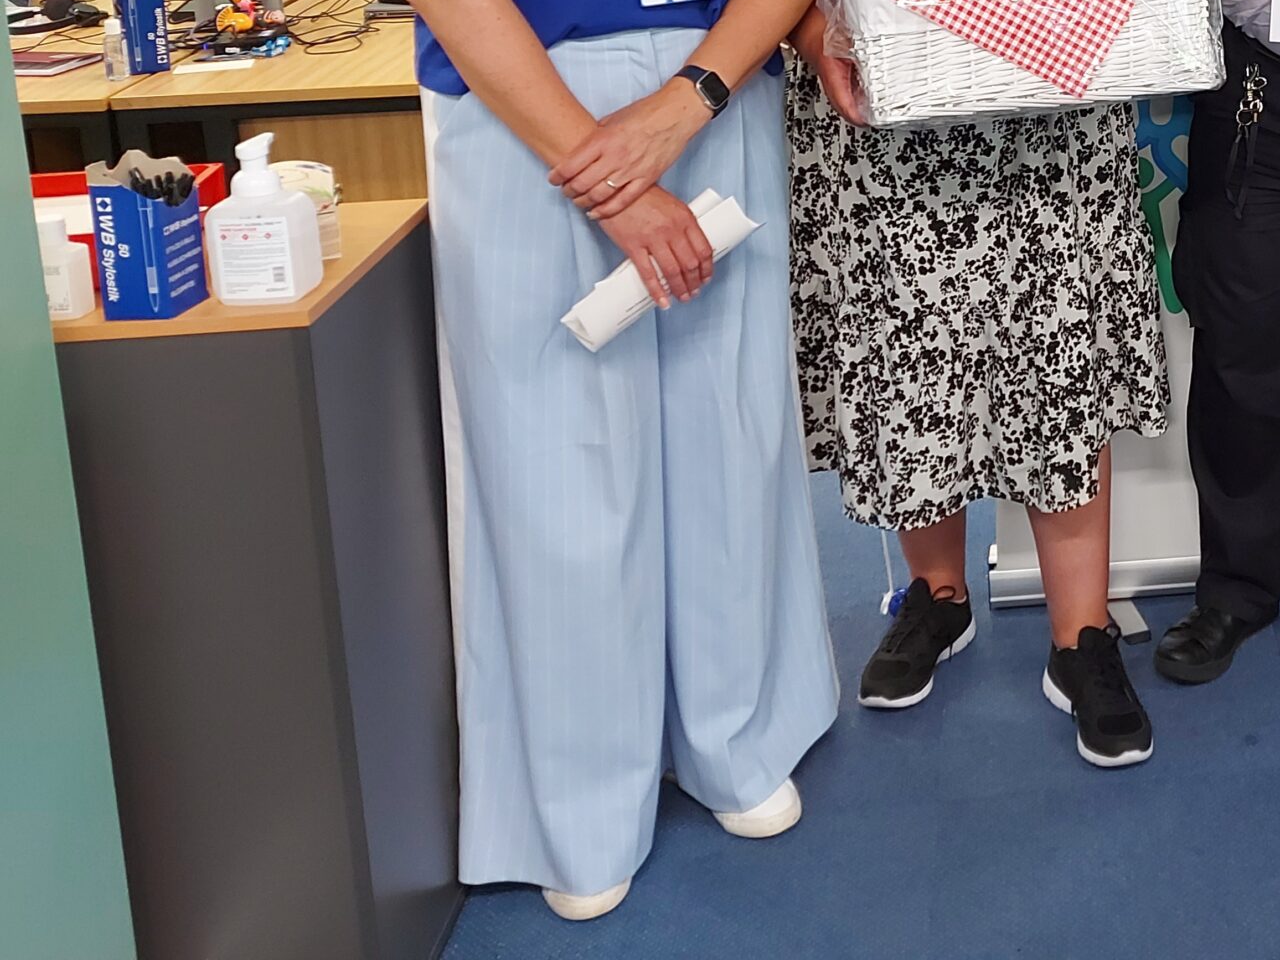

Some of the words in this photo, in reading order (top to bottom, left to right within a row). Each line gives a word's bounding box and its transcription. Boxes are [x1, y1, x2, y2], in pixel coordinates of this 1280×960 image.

[156, 38, 168, 55] WB
[99, 215, 116, 246] WB
[101, 248, 120, 303] Stylostik
